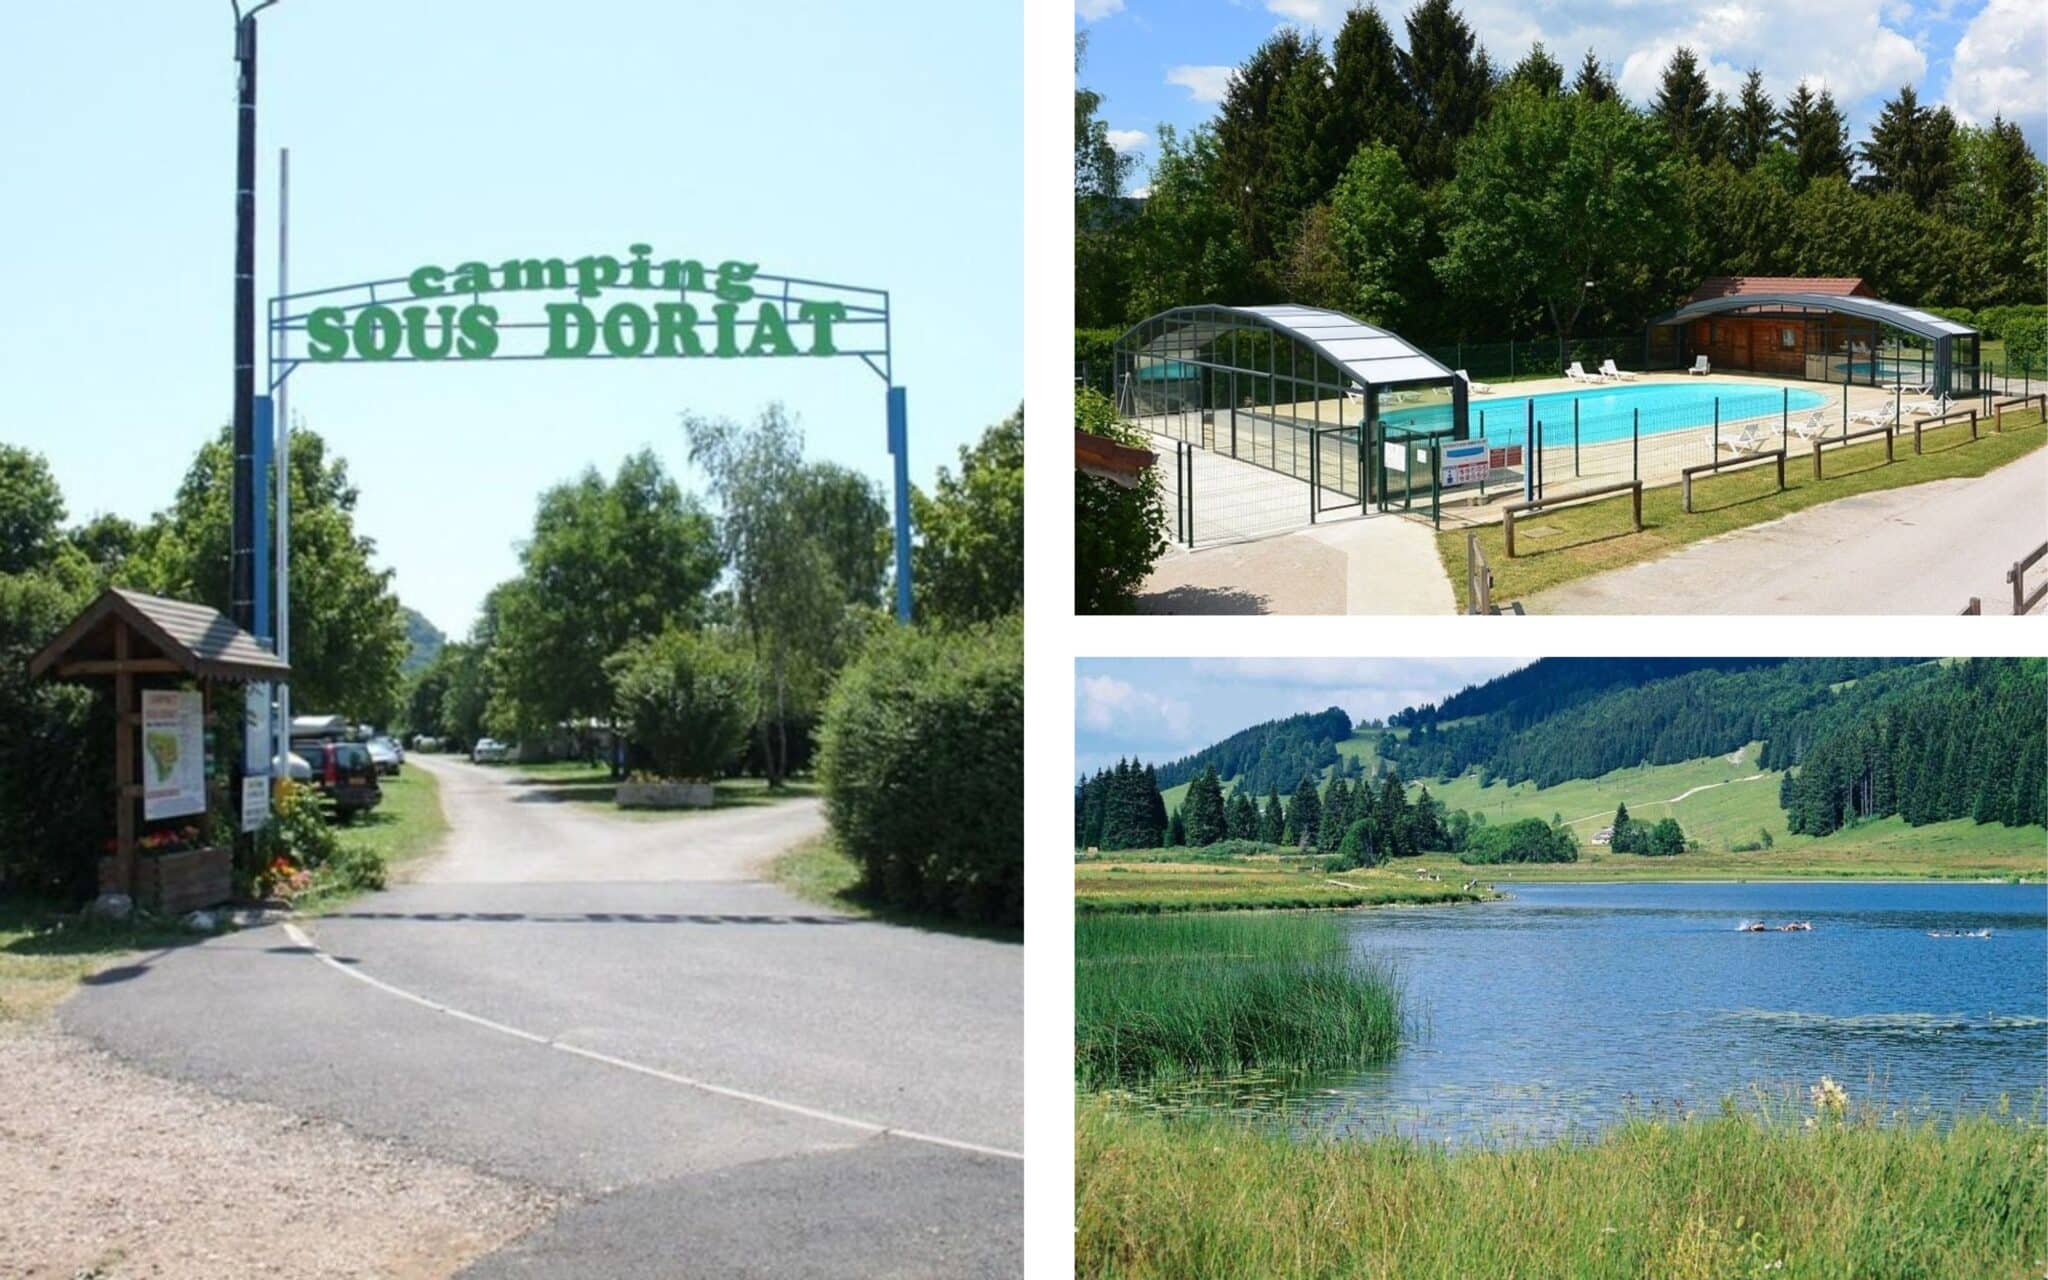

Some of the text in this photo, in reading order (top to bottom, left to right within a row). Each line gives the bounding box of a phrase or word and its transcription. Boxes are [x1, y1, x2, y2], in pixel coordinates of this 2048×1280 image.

[408, 243, 759, 301] camping
[307, 301, 847, 361] SOUS DORIAT
